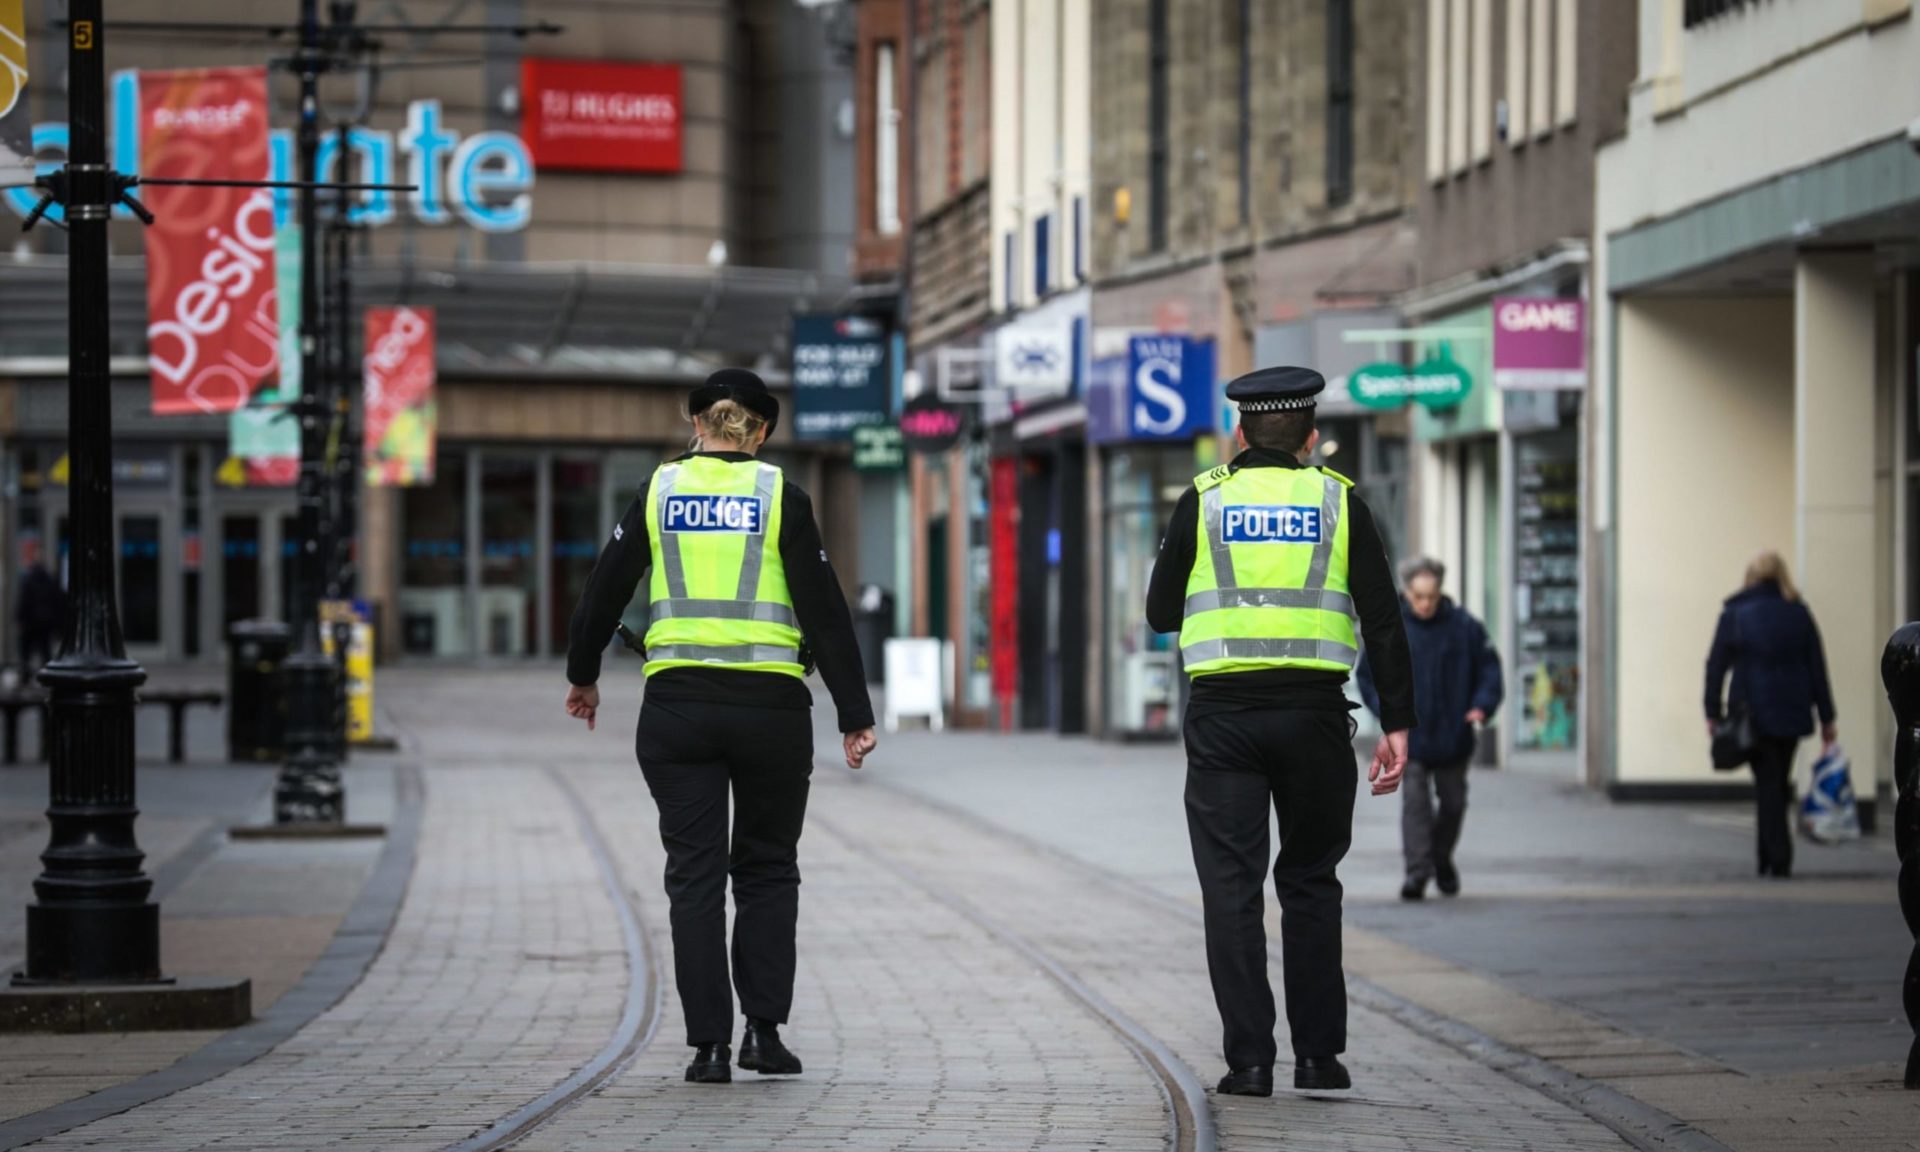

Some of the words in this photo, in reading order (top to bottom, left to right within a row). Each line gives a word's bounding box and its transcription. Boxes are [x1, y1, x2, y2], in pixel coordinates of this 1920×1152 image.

[76, 24, 90, 46] 5
[1500, 302, 1578, 332] GAME
[1134, 356, 1187, 435] S
[667, 500, 757, 528] POLICE
[1226, 510, 1317, 538] POLICE
